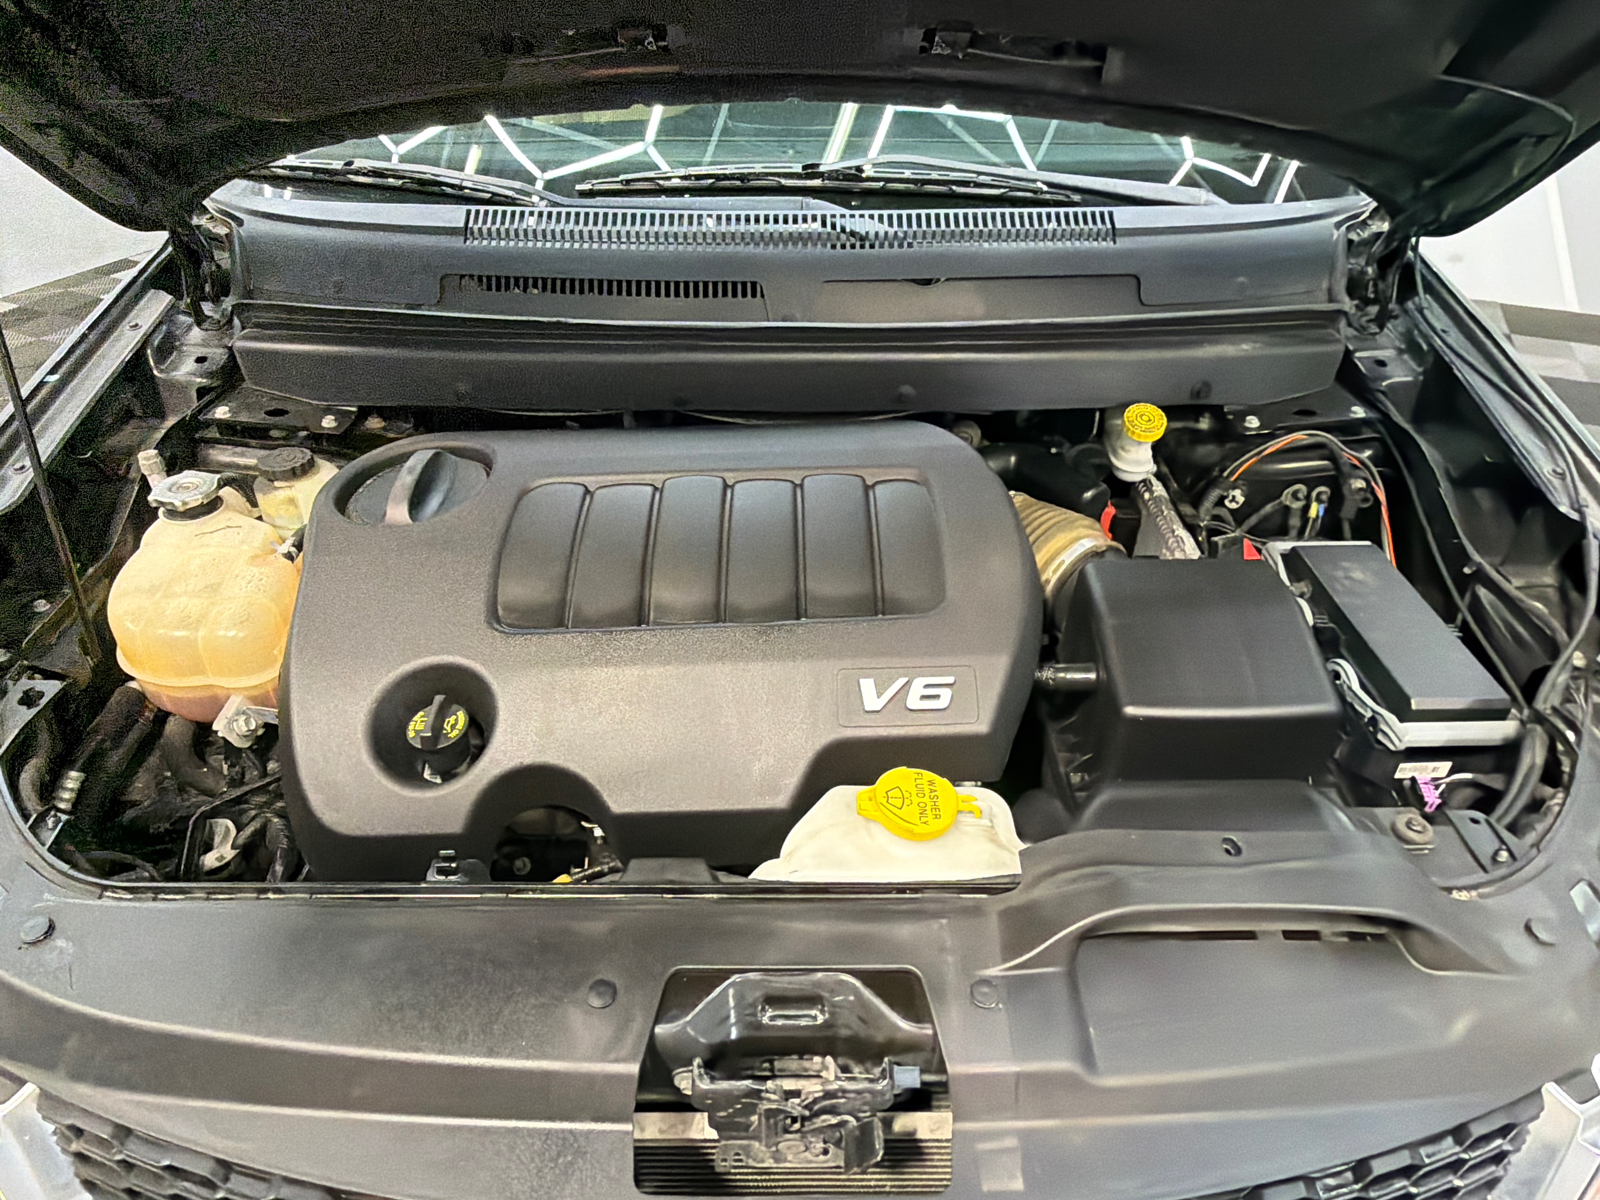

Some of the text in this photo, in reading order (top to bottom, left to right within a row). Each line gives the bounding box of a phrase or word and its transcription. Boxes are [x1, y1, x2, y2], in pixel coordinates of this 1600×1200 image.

[859, 676, 955, 712] V6
[913, 772, 930, 826] FLUID ONLY
[926, 779, 942, 820] WASHER
